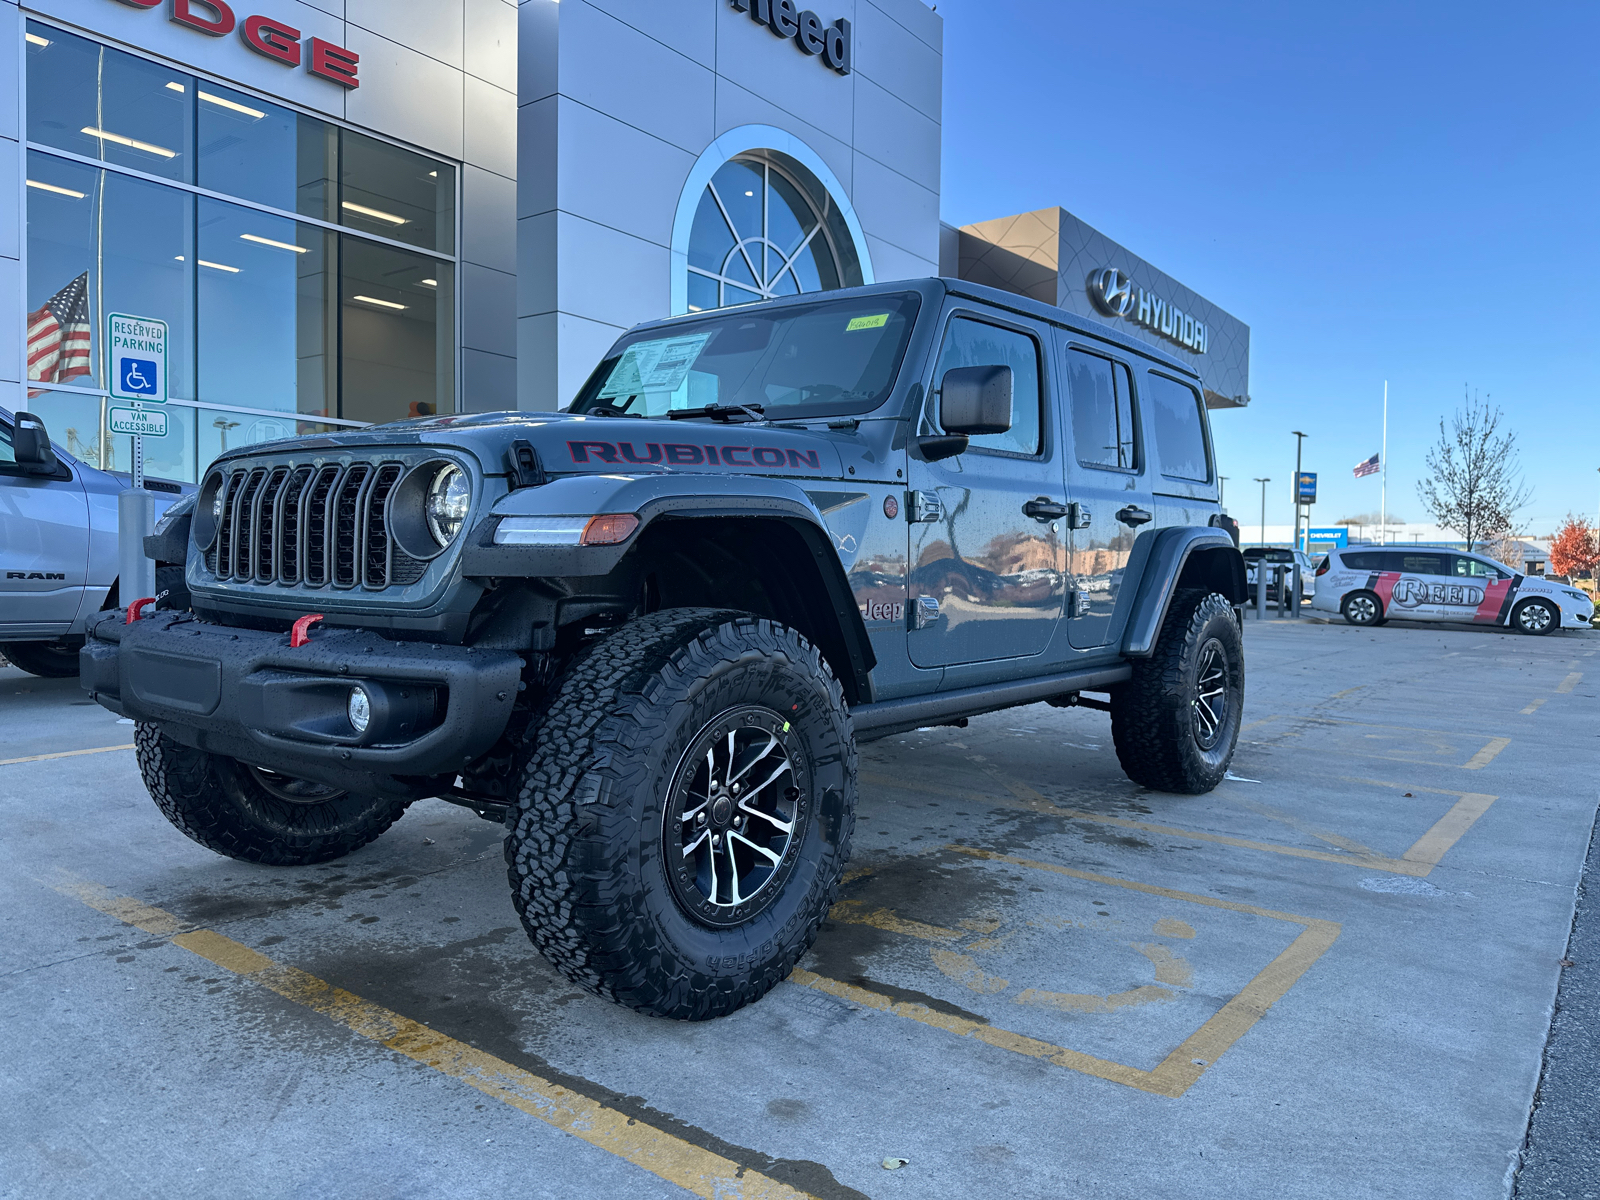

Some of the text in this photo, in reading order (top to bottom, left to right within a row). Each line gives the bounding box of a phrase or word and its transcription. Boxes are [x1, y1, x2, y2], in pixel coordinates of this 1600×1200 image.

[116, 0, 359, 90] DGE
[114, 321, 162, 339] RESERVED
[1137, 287, 1208, 354] HYUNDAI
[114, 336, 163, 353] PARKING
[113, 421, 164, 433] ACCESSIBLE
[131, 412, 148, 422] VAN
[566, 440, 821, 469] RUBICON
[6, 572, 66, 581] RAM
[1396, 577, 1482, 607] REED
[860, 598, 902, 623] Jeep
